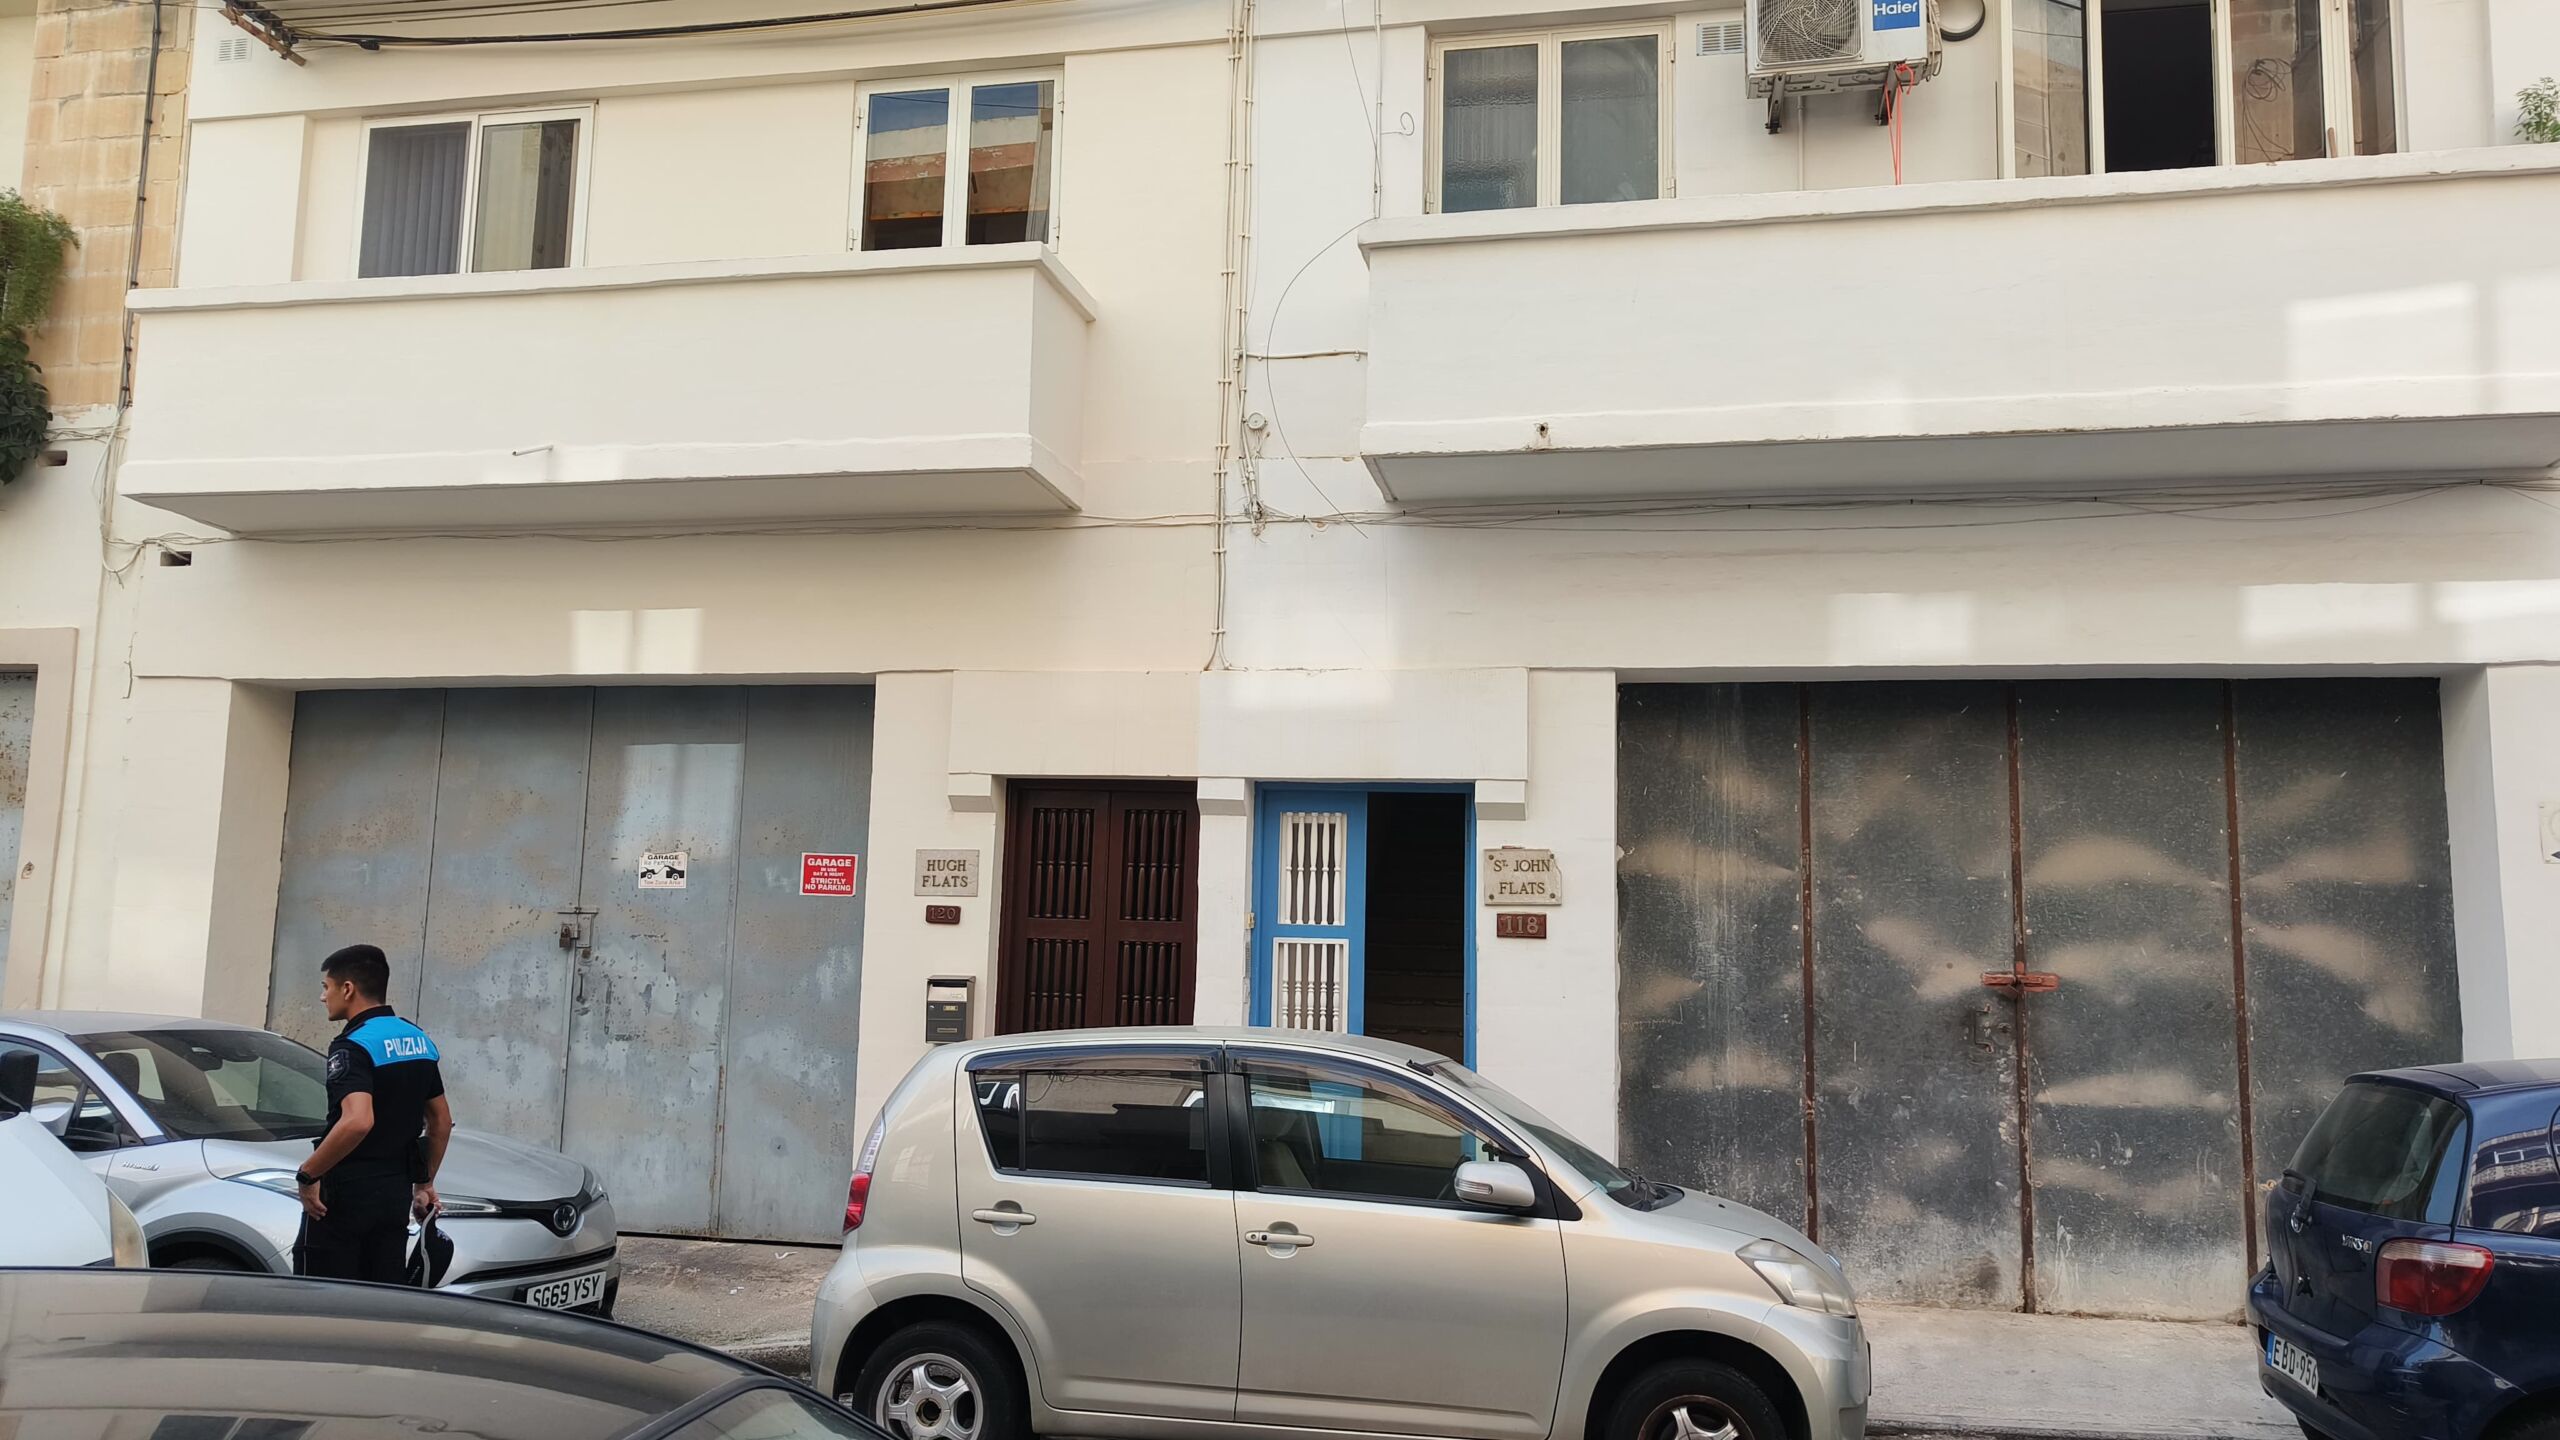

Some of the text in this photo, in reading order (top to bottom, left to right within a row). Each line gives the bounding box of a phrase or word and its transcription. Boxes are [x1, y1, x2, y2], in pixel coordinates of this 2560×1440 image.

[1874, 1, 1918, 16] Haier
[807, 857, 852, 867] GARAGE
[927, 859, 967, 872] HUGH
[1513, 859, 1551, 872] JOHN
[922, 874, 969, 888] FLATS
[1499, 881, 1546, 895] FLATS
[930, 907, 956, 920] 120
[1505, 915, 1539, 934] 118
[533, 1275, 601, 1308] SG69 YSY
